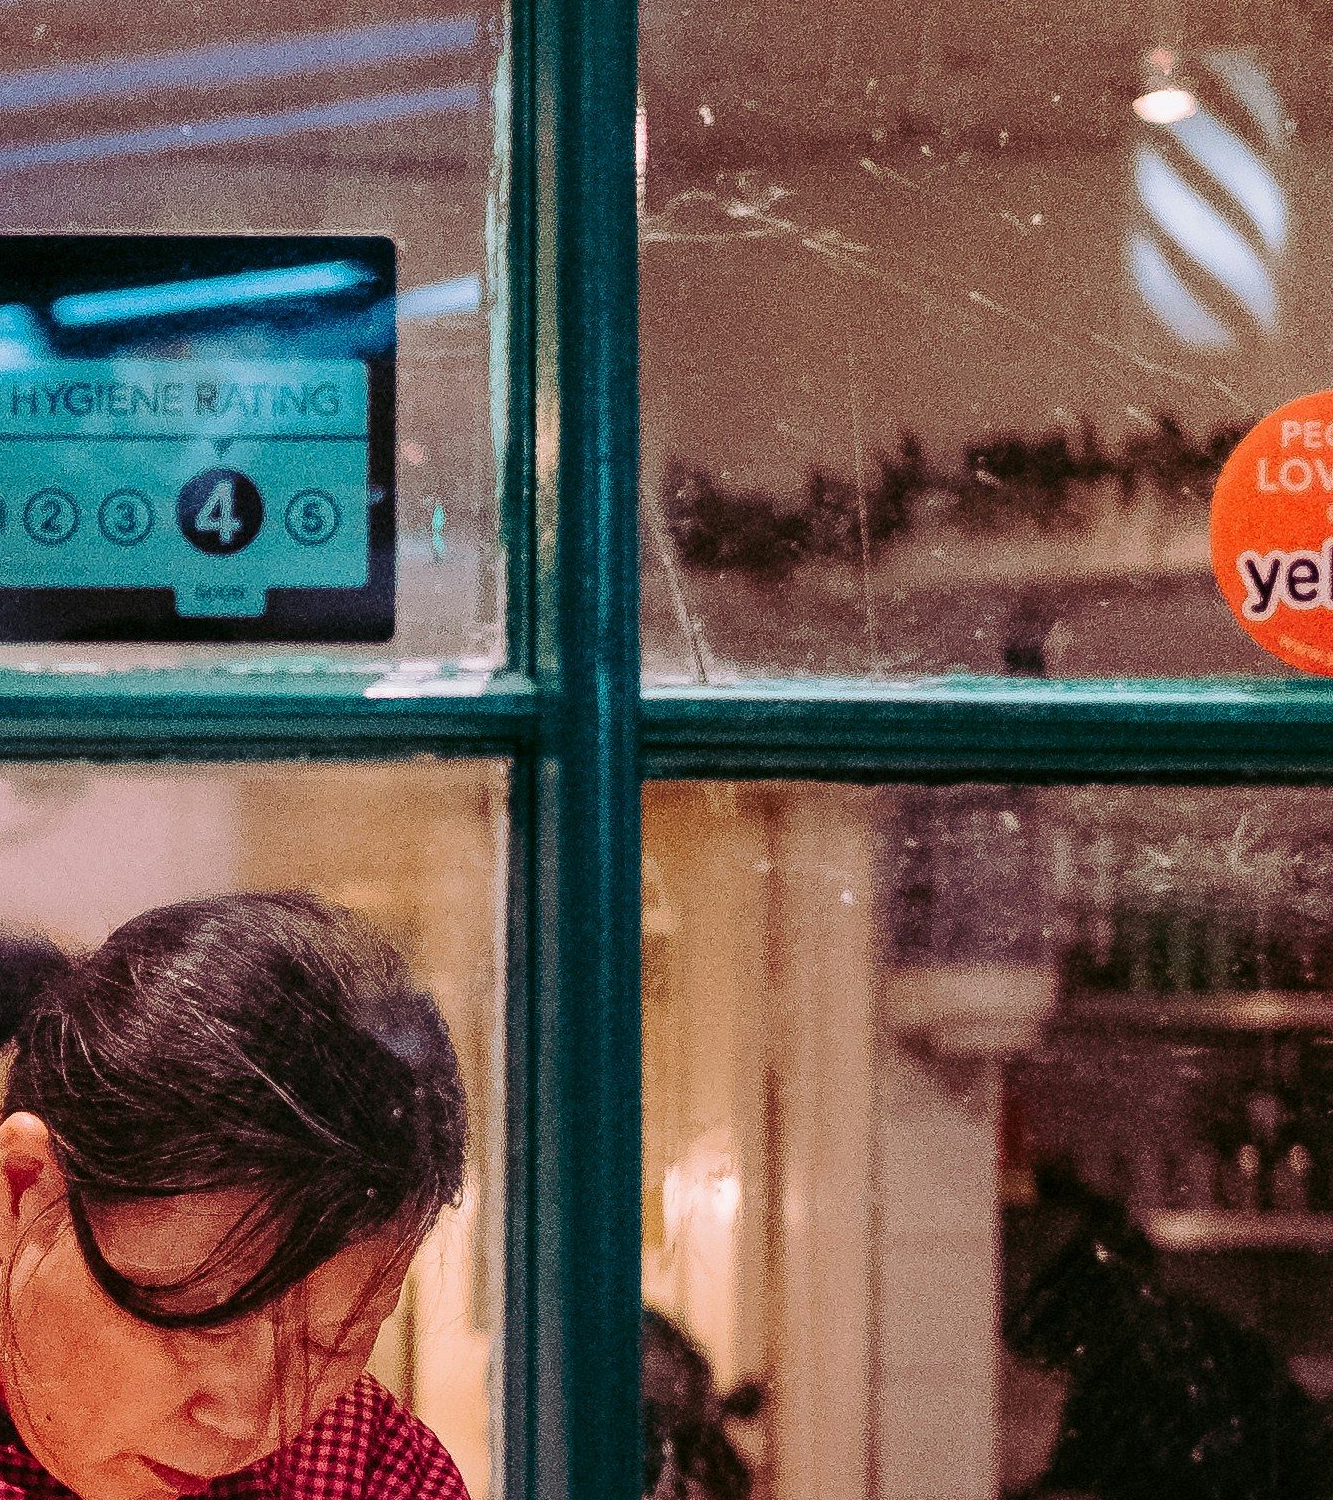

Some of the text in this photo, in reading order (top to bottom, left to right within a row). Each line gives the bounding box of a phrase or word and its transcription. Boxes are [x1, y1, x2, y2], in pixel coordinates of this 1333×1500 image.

[11, 380, 184, 418] HYGIENE
[196, 380, 341, 417] RATING
[1282, 419, 1333, 449] PE
[40, 500, 63, 533] 2
[116, 500, 137, 533] 3
[194, 478, 241, 545] 4
[300, 501, 323, 534] 5
